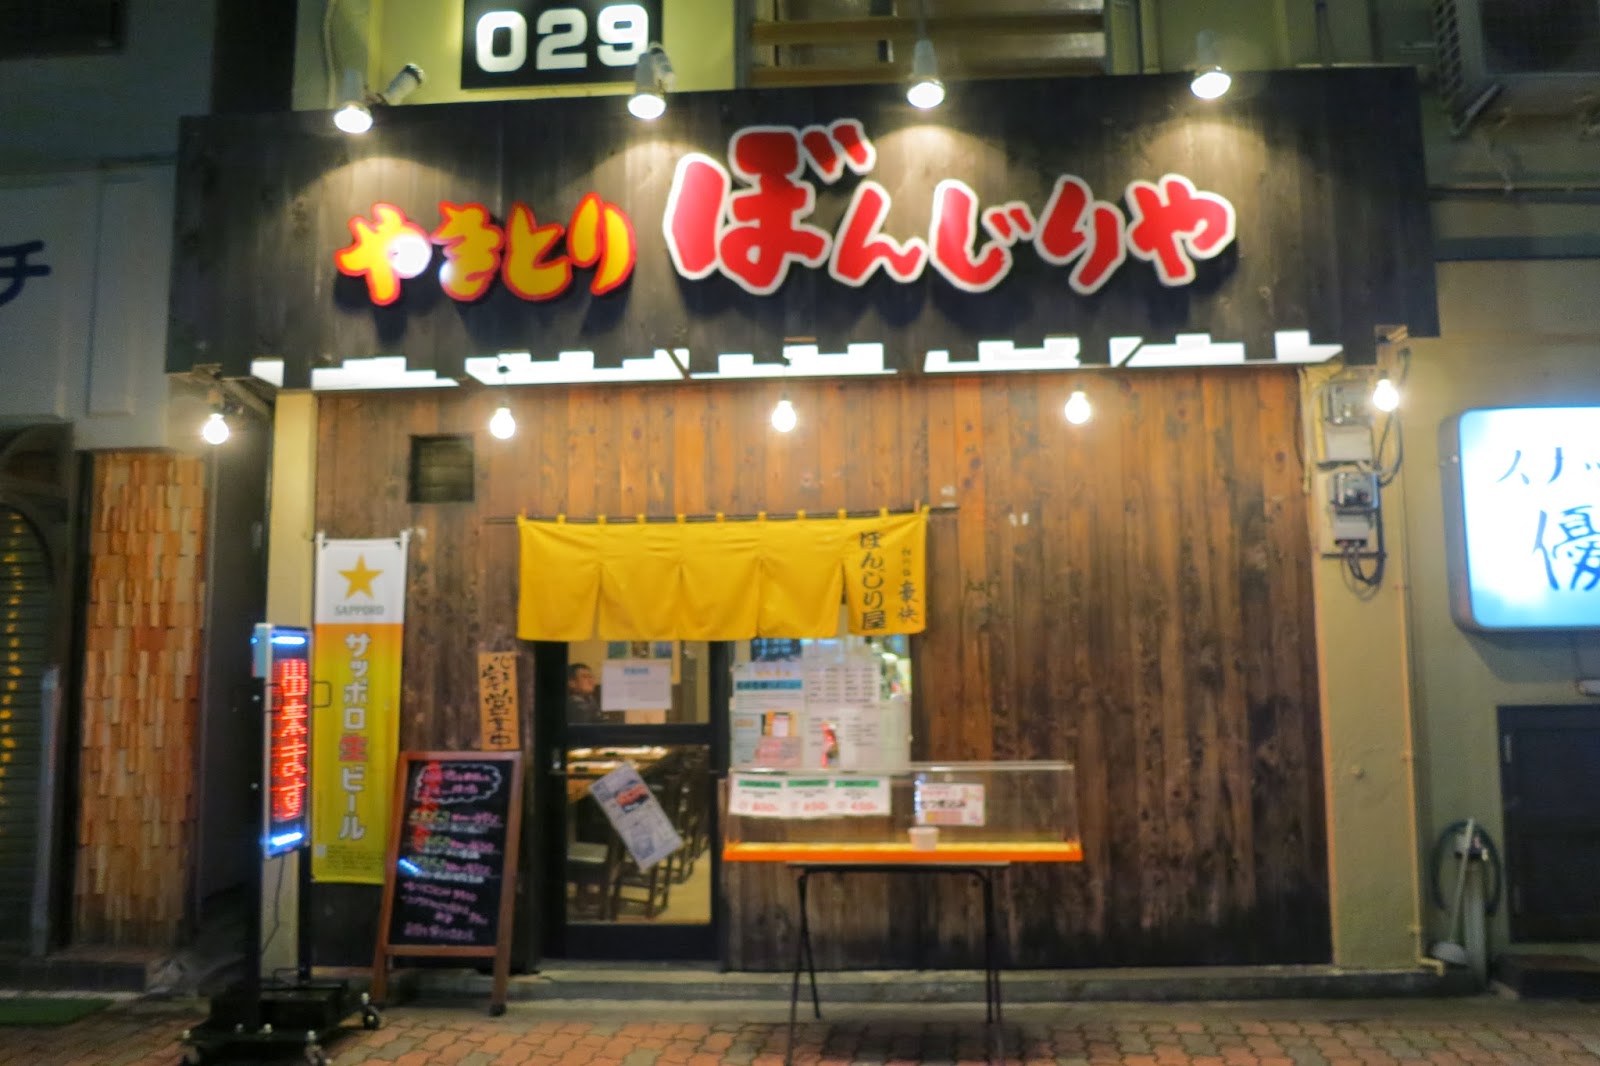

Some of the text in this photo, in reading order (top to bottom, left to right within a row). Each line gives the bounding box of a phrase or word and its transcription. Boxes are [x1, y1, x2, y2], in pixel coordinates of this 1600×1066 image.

[476, 4, 649, 73] 029
[335, 118, 1236, 306] やきとり ぼんじりや
[334, 604, 385, 616] SAPPORO
[339, 632, 372, 841] サッポロ生ビール
